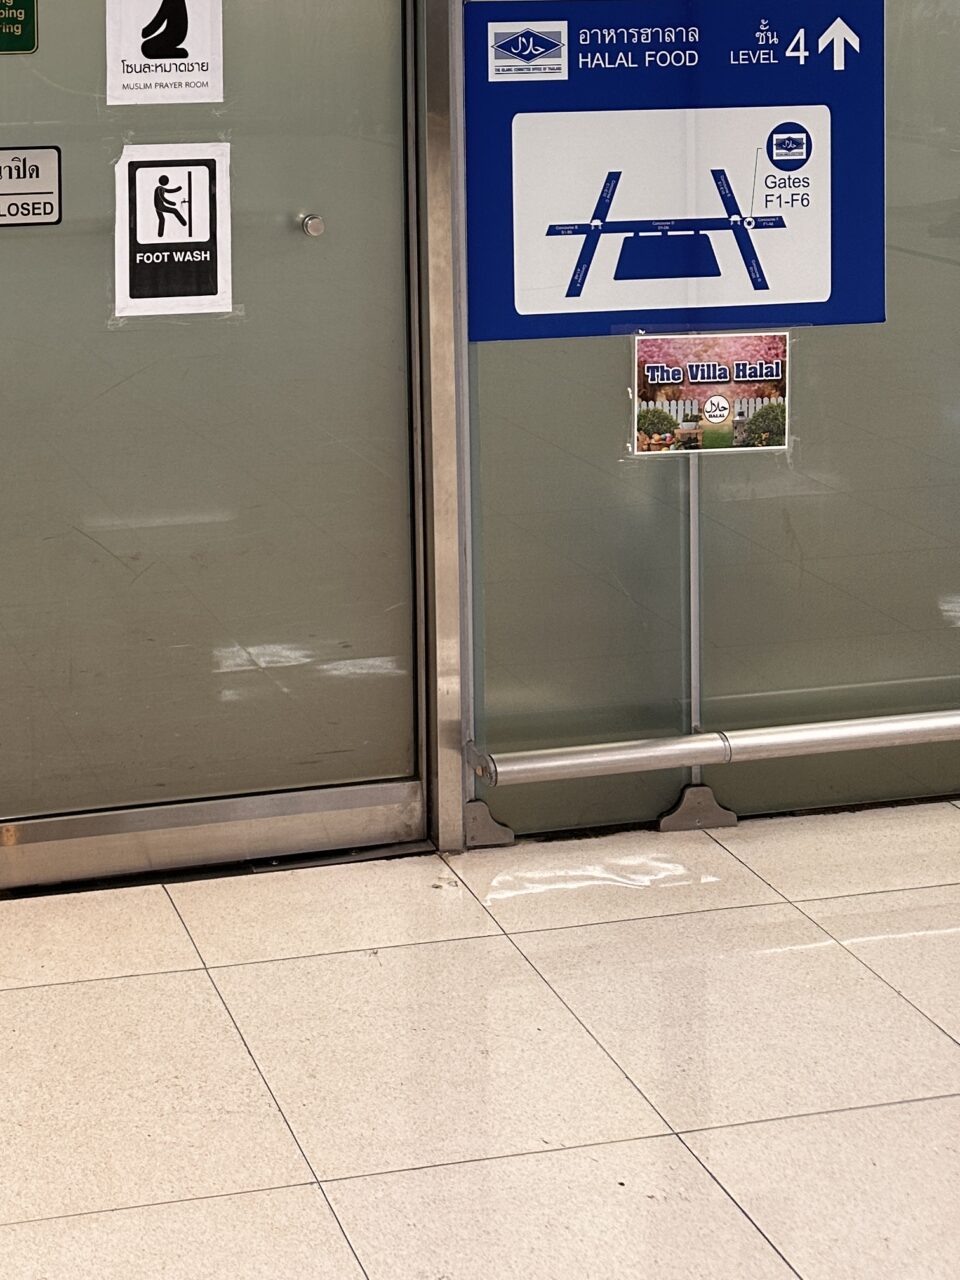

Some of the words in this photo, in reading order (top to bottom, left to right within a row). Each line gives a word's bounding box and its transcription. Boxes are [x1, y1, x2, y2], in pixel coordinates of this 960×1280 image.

[580, 27, 698, 44] อาหารฮาลาล
[756, 19, 778, 44] ชั้น
[786, 28, 809, 64] 4
[579, 52, 638, 68] HALAL
[646, 51, 698, 66] FOOD
[731, 50, 778, 64] LEVEL
[121, 58, 208, 74] โซนละหมาดชาย
[765, 175, 810, 189] Gates
[765, 193, 810, 208] F1-F6
[136, 252, 170, 263] FOOT
[173, 251, 210, 262] WASH
[645, 363, 683, 384] The
[687, 361, 729, 382] Villa
[733, 359, 782, 380] Halal
